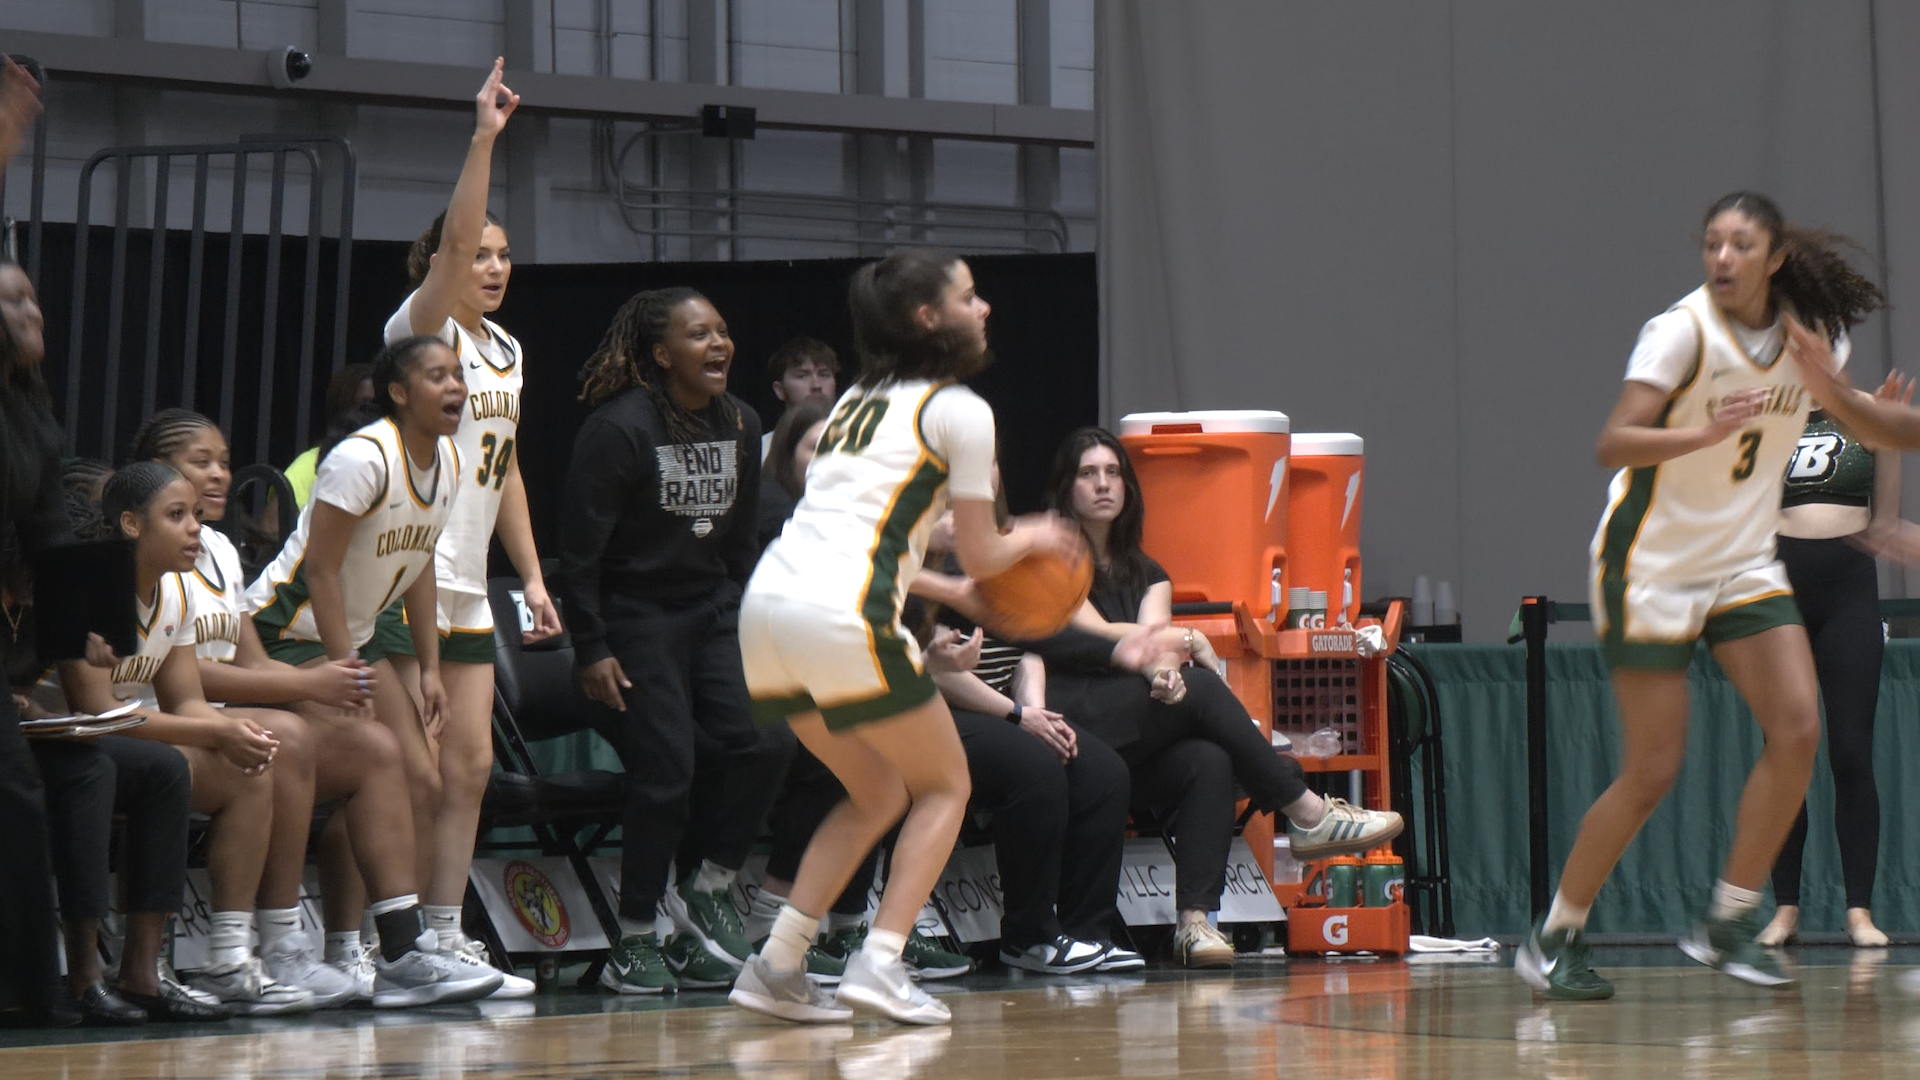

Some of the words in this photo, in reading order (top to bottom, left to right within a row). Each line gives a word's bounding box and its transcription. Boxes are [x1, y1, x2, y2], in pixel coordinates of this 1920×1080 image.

[475, 431, 515, 491] 34
[684, 446, 722, 476] END
[1732, 429, 1763, 483] 3
[1787, 431, 1842, 481] B
[375, 564, 408, 614] 1
[1312, 634, 1354, 652] GATORADE
[1123, 864, 1170, 897] LLC
[1323, 914, 1349, 946] G
